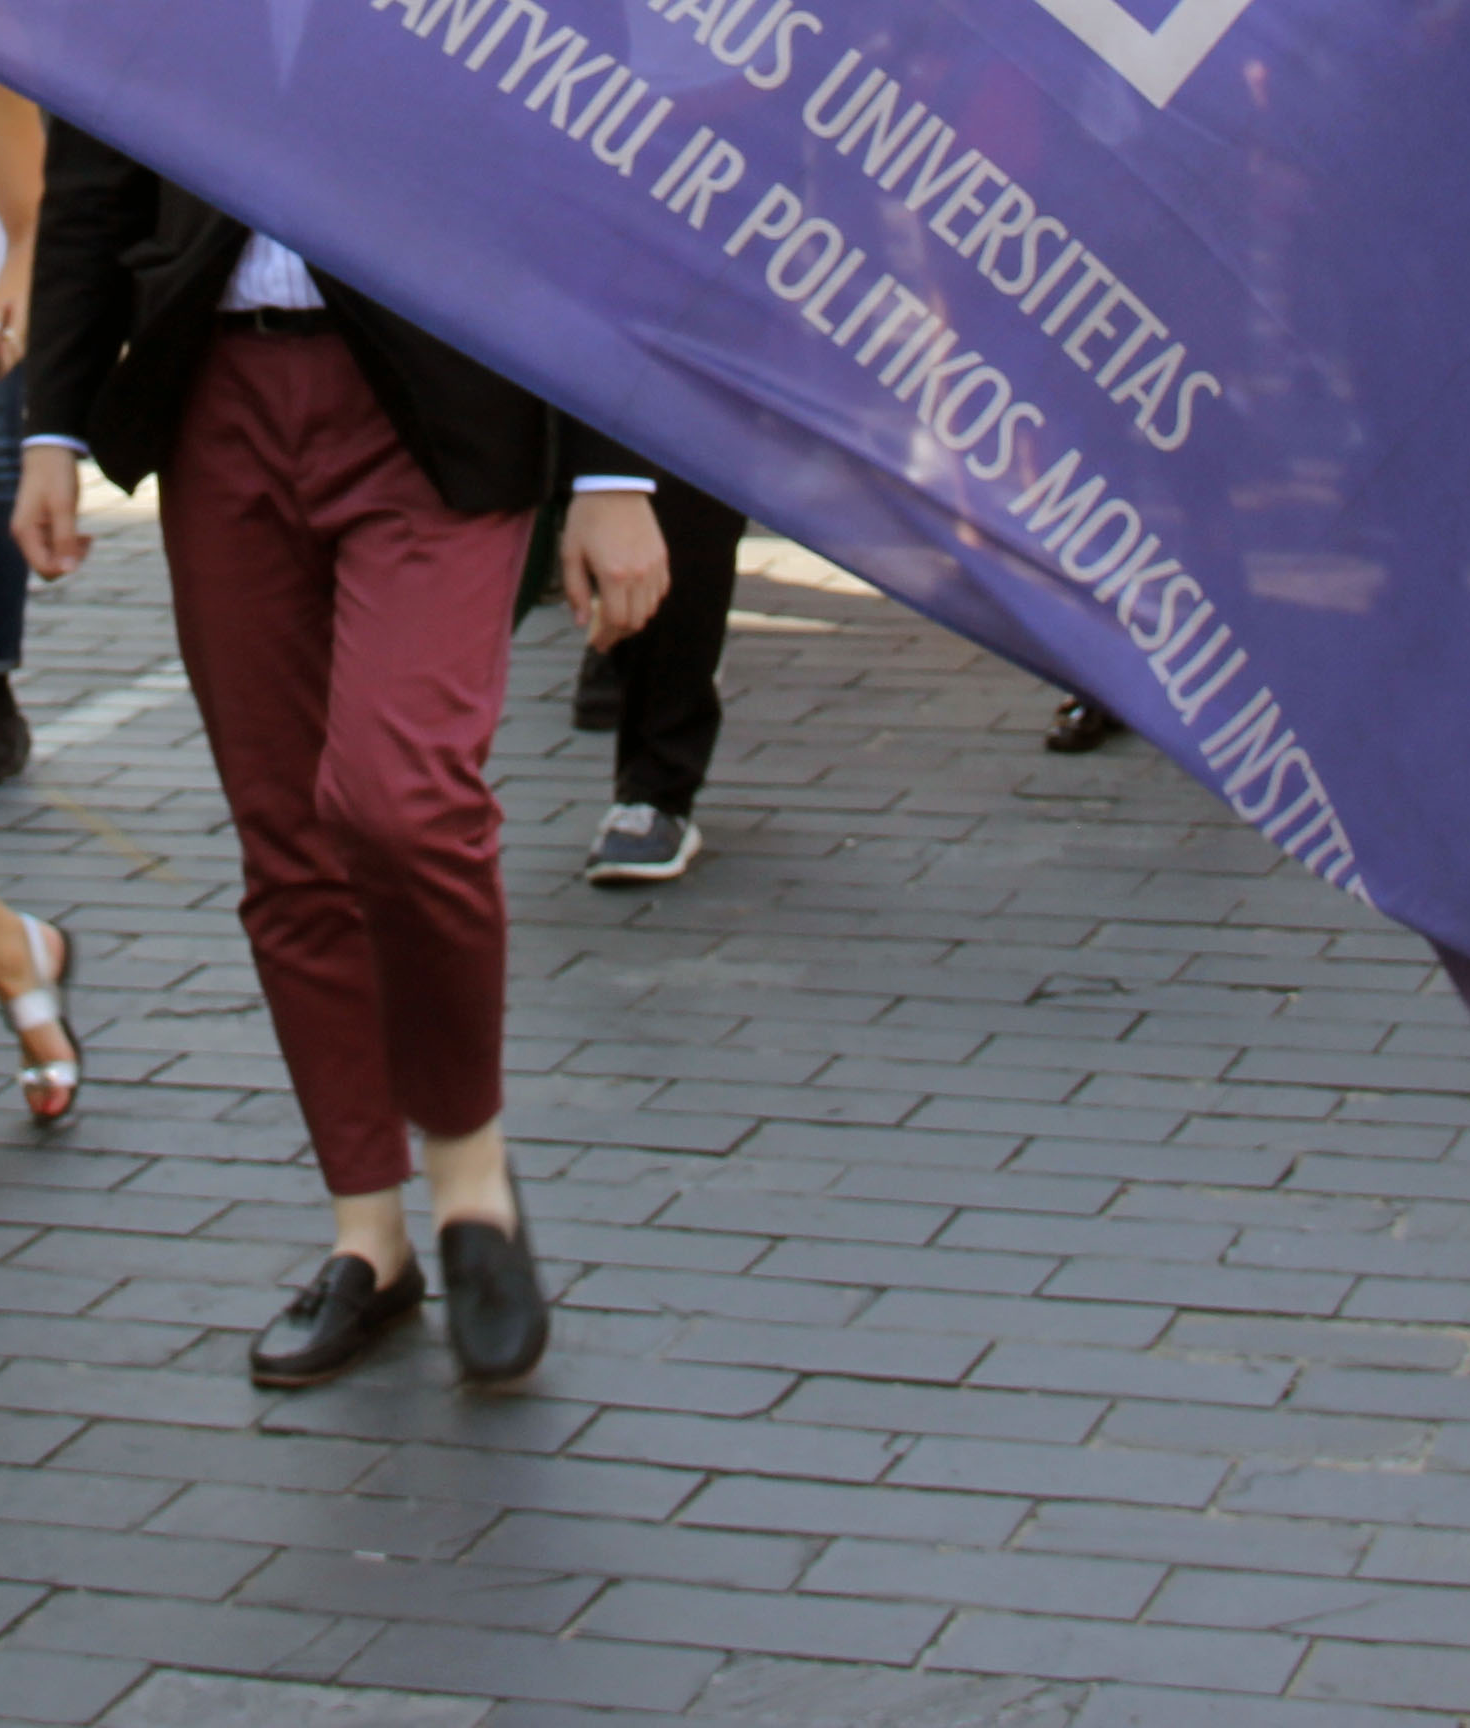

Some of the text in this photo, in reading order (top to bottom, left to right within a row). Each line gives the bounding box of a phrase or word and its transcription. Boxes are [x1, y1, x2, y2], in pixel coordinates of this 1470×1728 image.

[650, 126, 746, 229] IR
[723, 183, 1045, 481] POLITIKOS
[1008, 449, 1248, 726] MOKSLŲ
[1199, 685, 1377, 909] INSTIT
[802, 48, 1222, 452] UNIVERSITETAS
